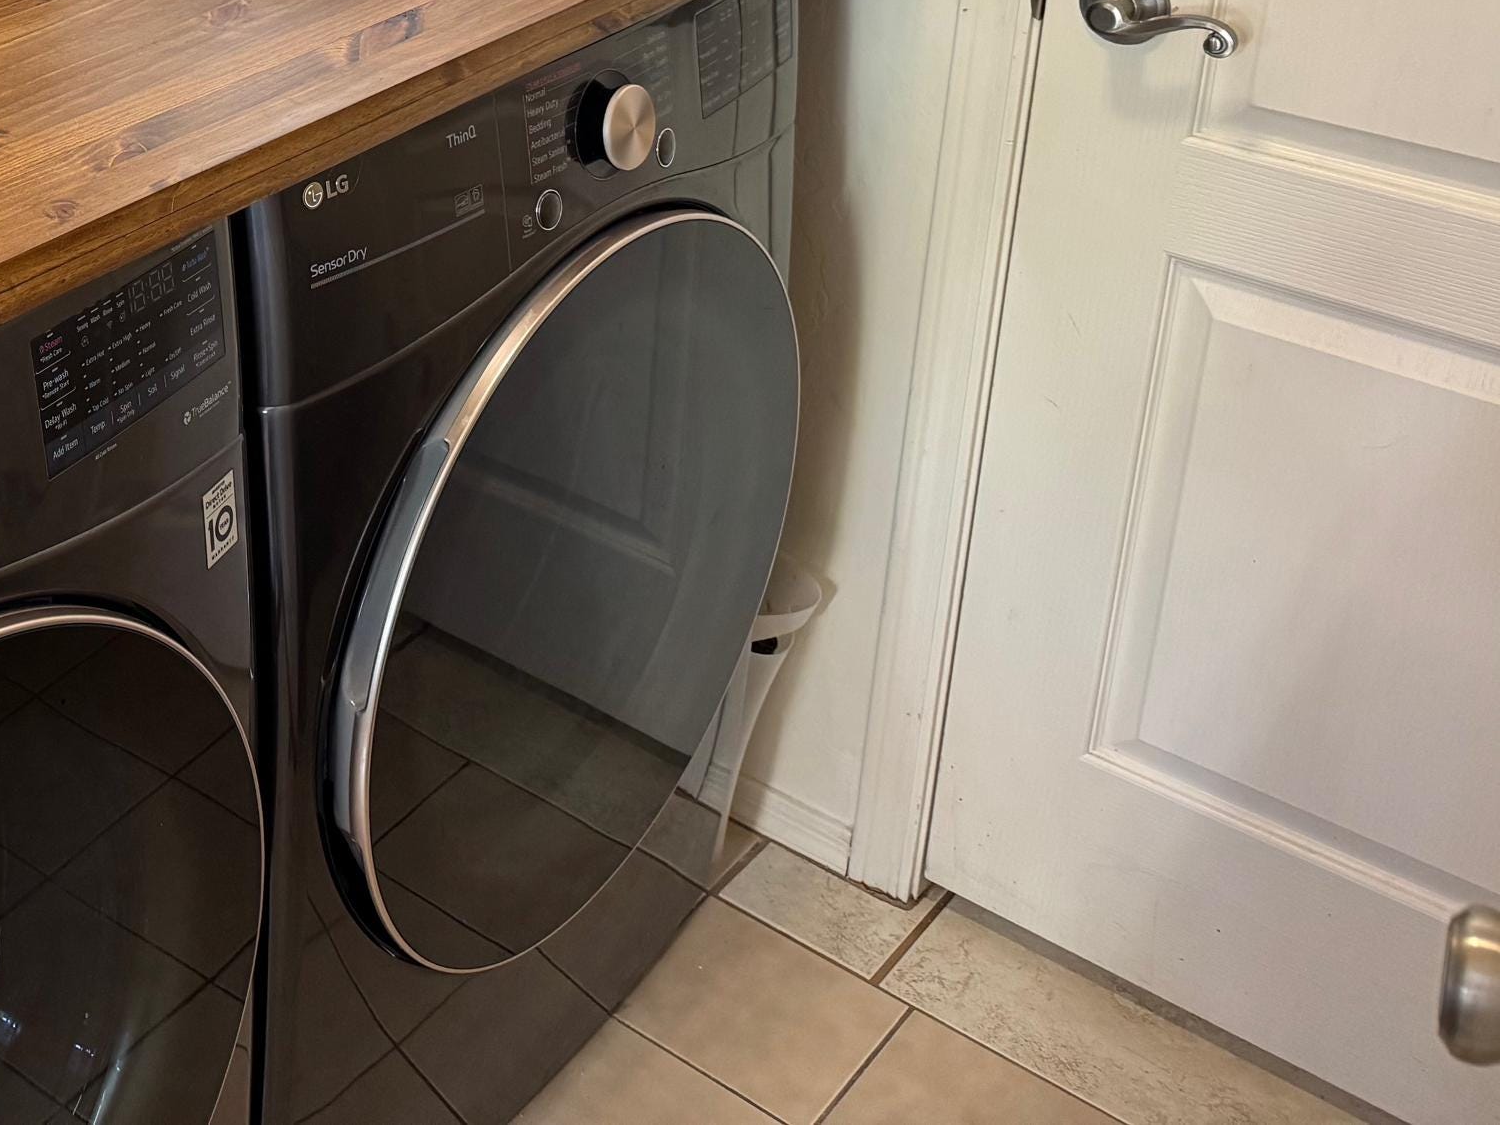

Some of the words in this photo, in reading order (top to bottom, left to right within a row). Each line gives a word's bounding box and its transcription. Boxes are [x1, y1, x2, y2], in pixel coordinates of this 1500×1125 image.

[446, 125, 477, 149] ThinQ
[325, 174, 350, 199] LG
[170, 365, 185, 380] Signal
[148, 383, 158, 396] Soil
[208, 504, 234, 553] 10
